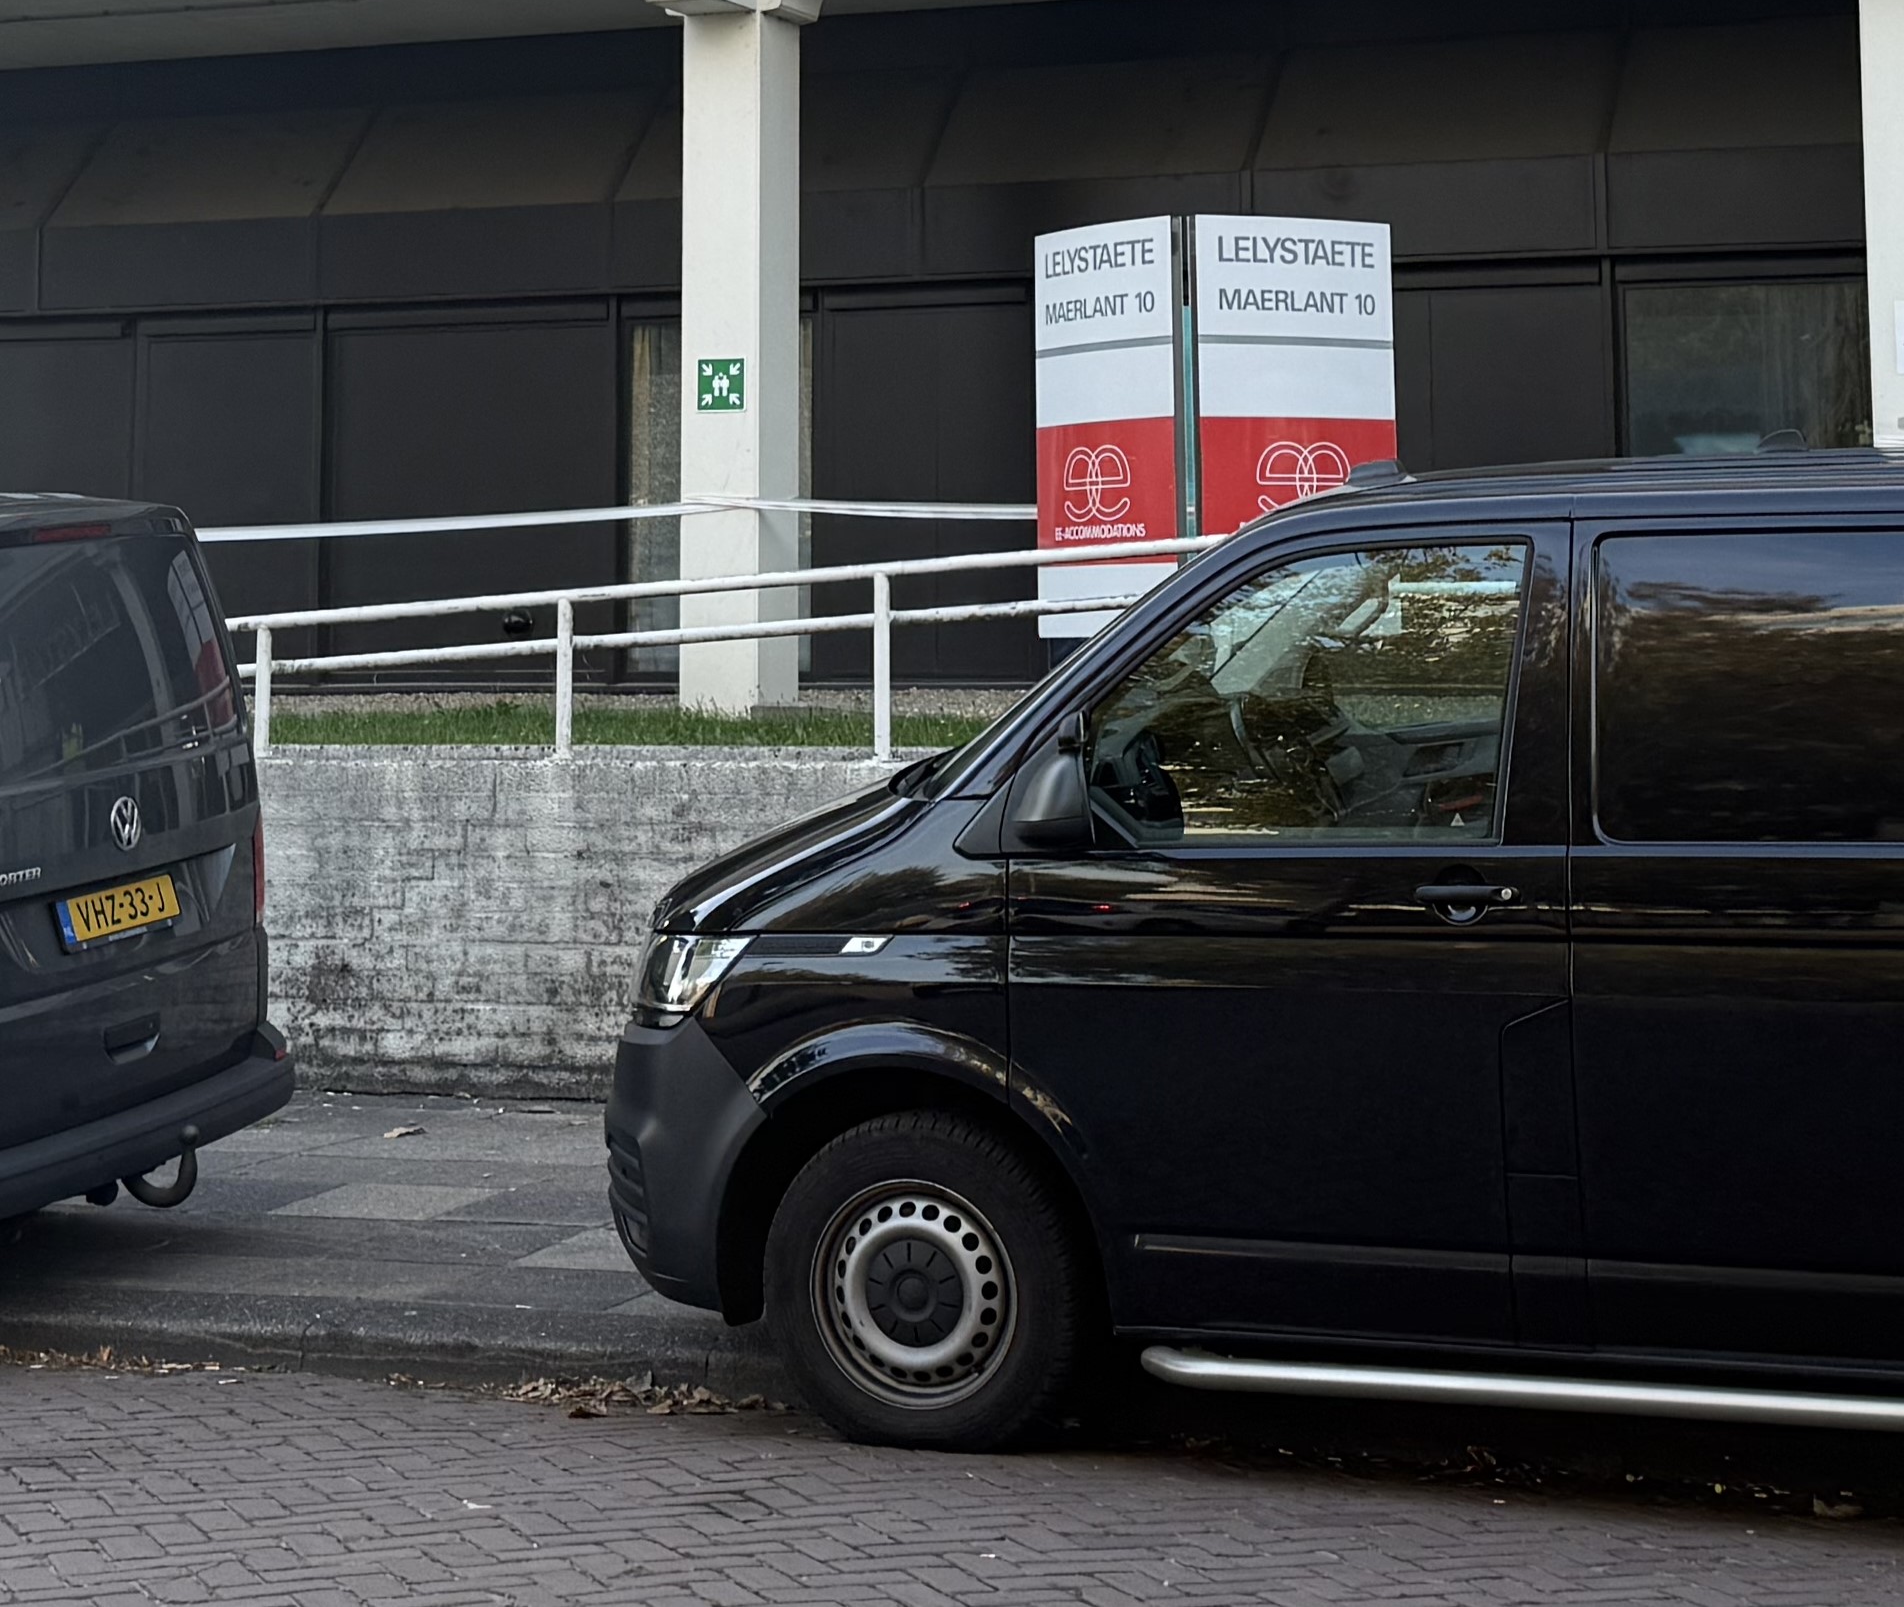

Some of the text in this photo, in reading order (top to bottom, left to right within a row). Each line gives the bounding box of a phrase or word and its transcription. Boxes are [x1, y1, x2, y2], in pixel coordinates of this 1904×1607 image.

[1044, 238, 1155, 279] LELYSTAETE
[1217, 235, 1375, 269] LELYSTAETE
[1045, 290, 1155, 326] MAERLANT 10
[1218, 288, 1376, 316] MAERLANT 10
